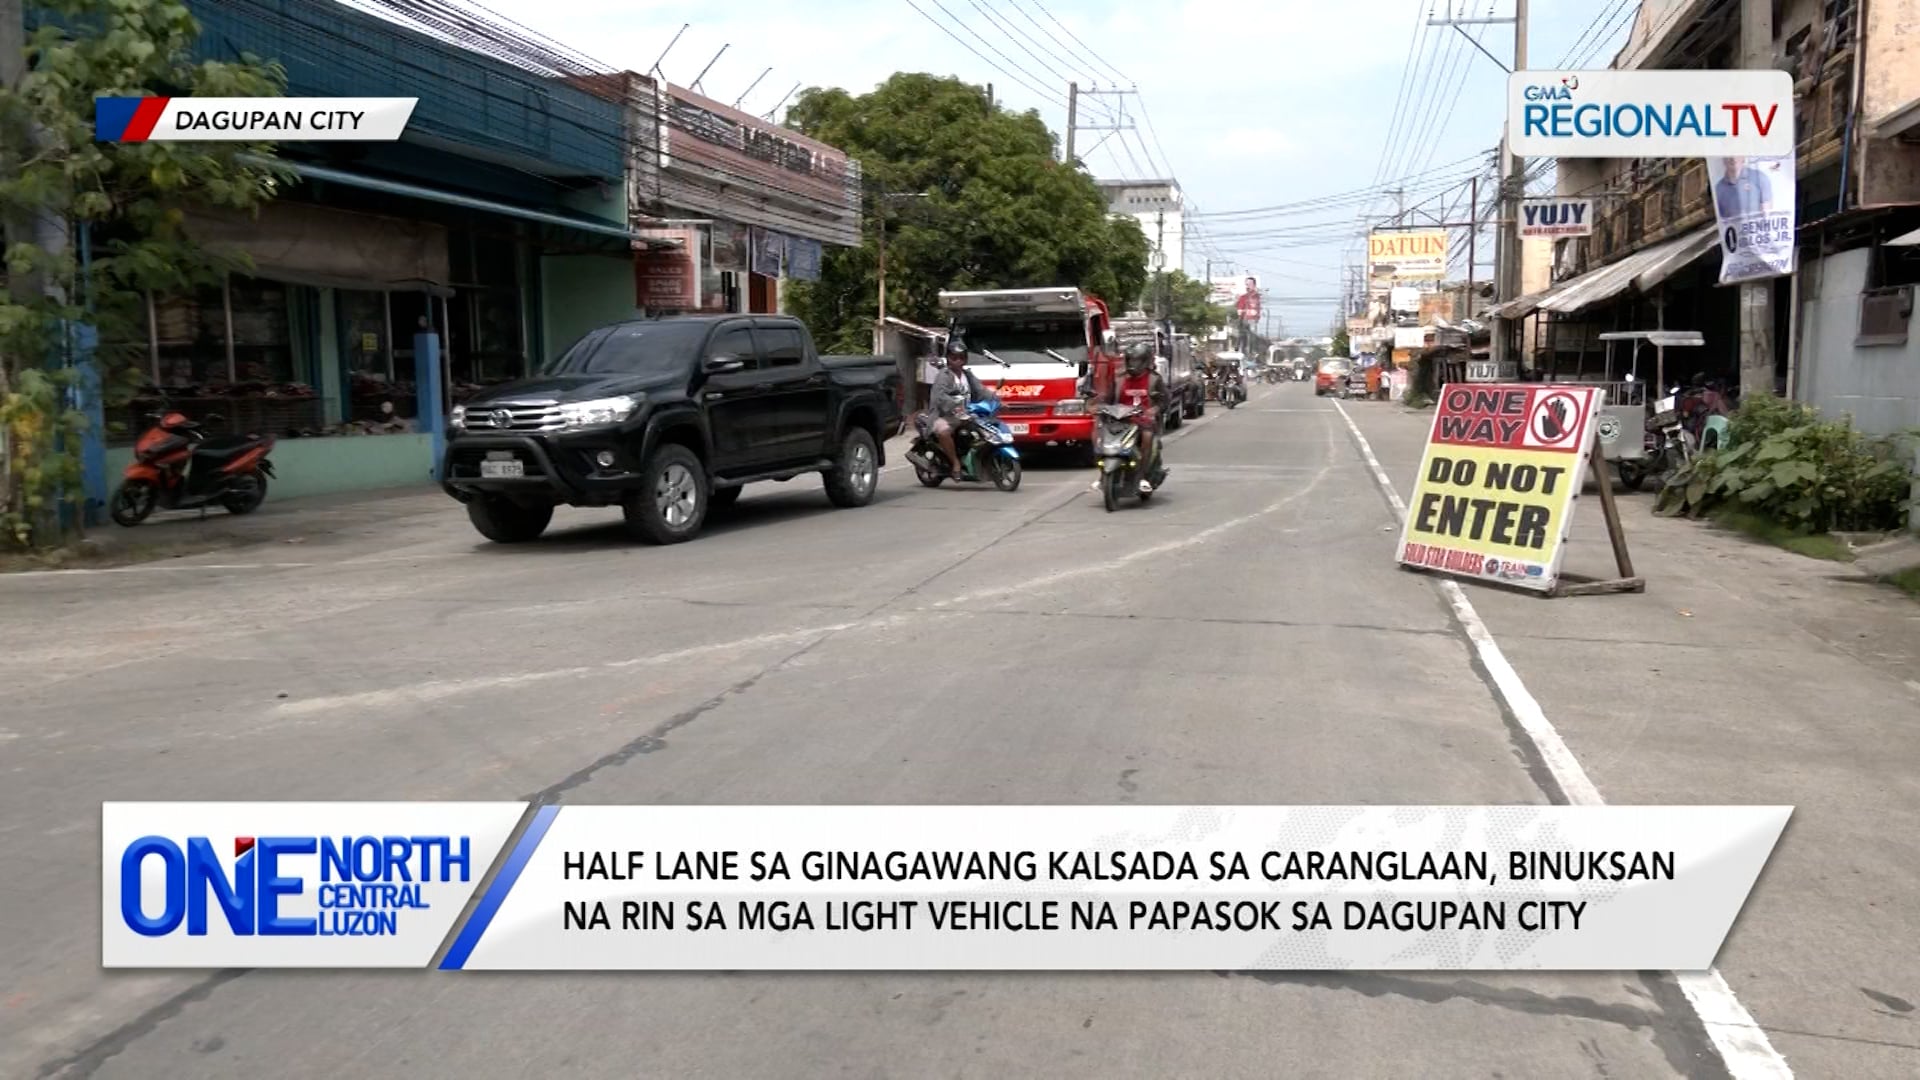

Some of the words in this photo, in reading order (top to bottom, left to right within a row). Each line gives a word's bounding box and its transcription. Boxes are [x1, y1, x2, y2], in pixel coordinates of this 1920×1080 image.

[1523, 202, 1588, 226] YUJY
[1371, 236, 1446, 256] DATUIN
[1447, 389, 1527, 416] ONE
[1440, 416, 1525, 443] WAY
[1428, 456, 1477, 487] DO
[1484, 462, 1566, 496] NOT
[1415, 492, 1551, 550] ENTER
